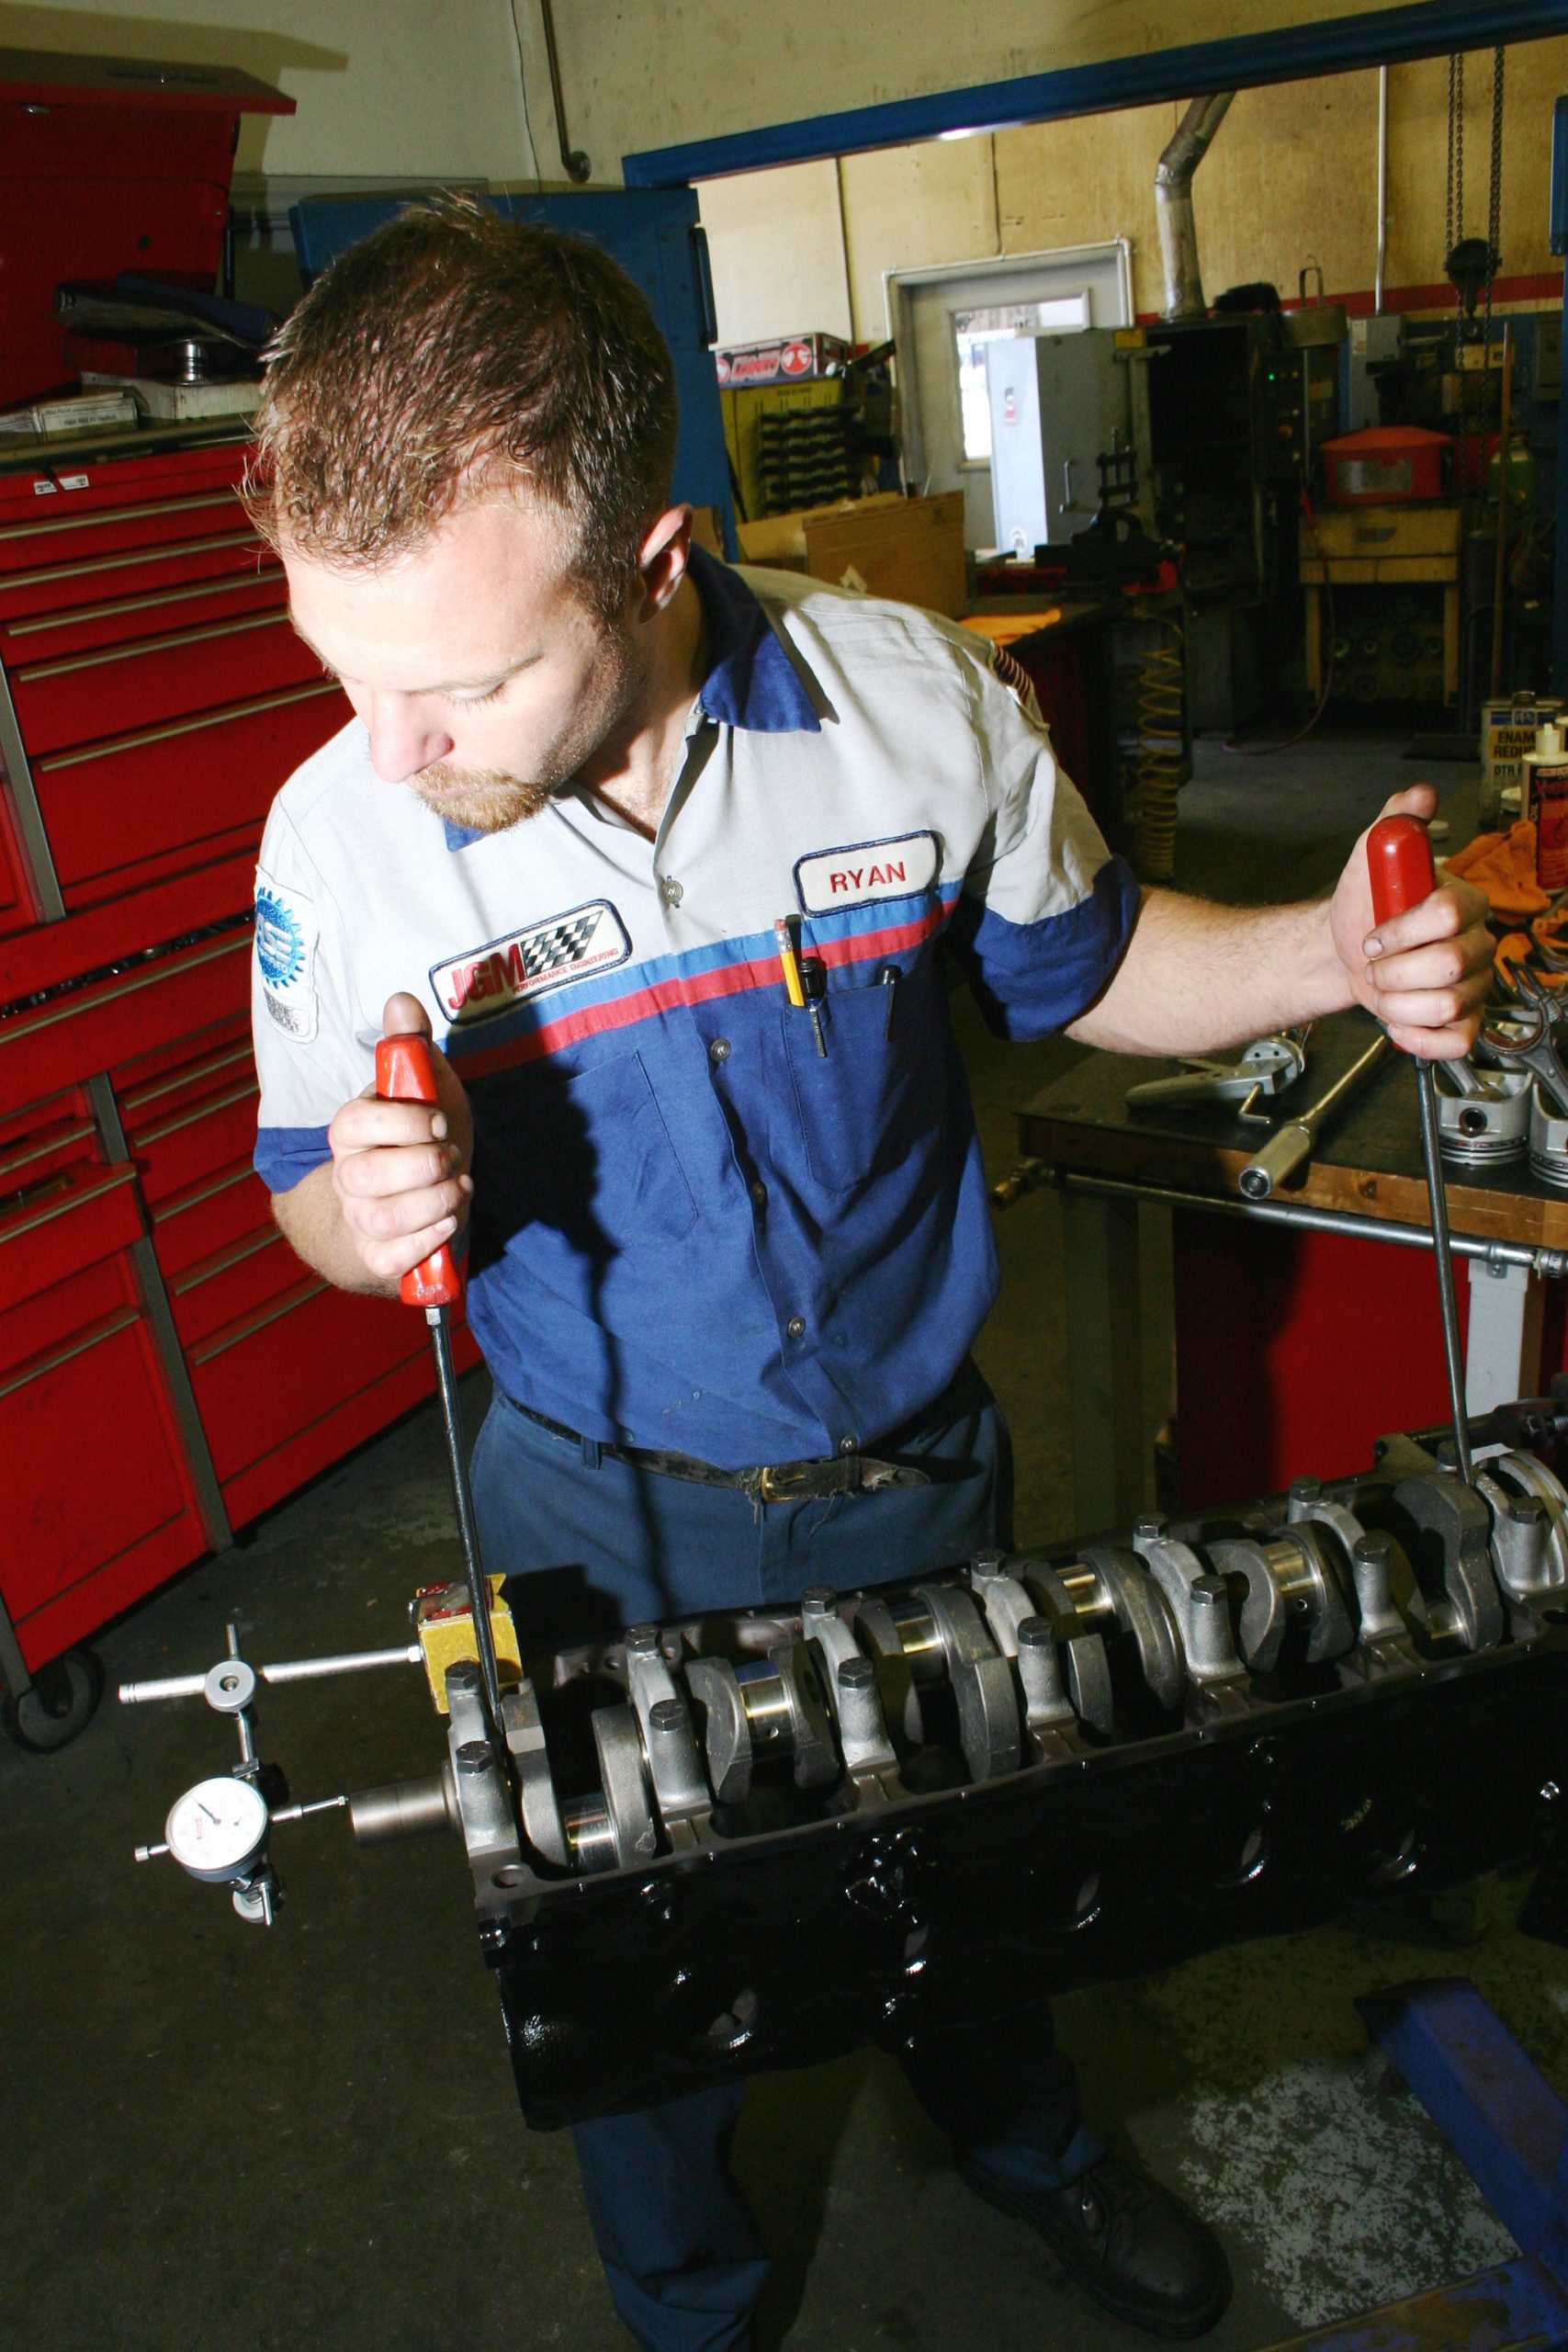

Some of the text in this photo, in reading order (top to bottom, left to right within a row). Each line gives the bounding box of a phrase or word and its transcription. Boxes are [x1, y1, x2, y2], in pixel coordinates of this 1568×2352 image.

[1498, 731, 1535, 743] ENAM
[829, 861, 907, 893] RYAN
[447, 943, 527, 1010] JGM
[512, 947, 619, 993] PERFORMANCE ENGINEERING
